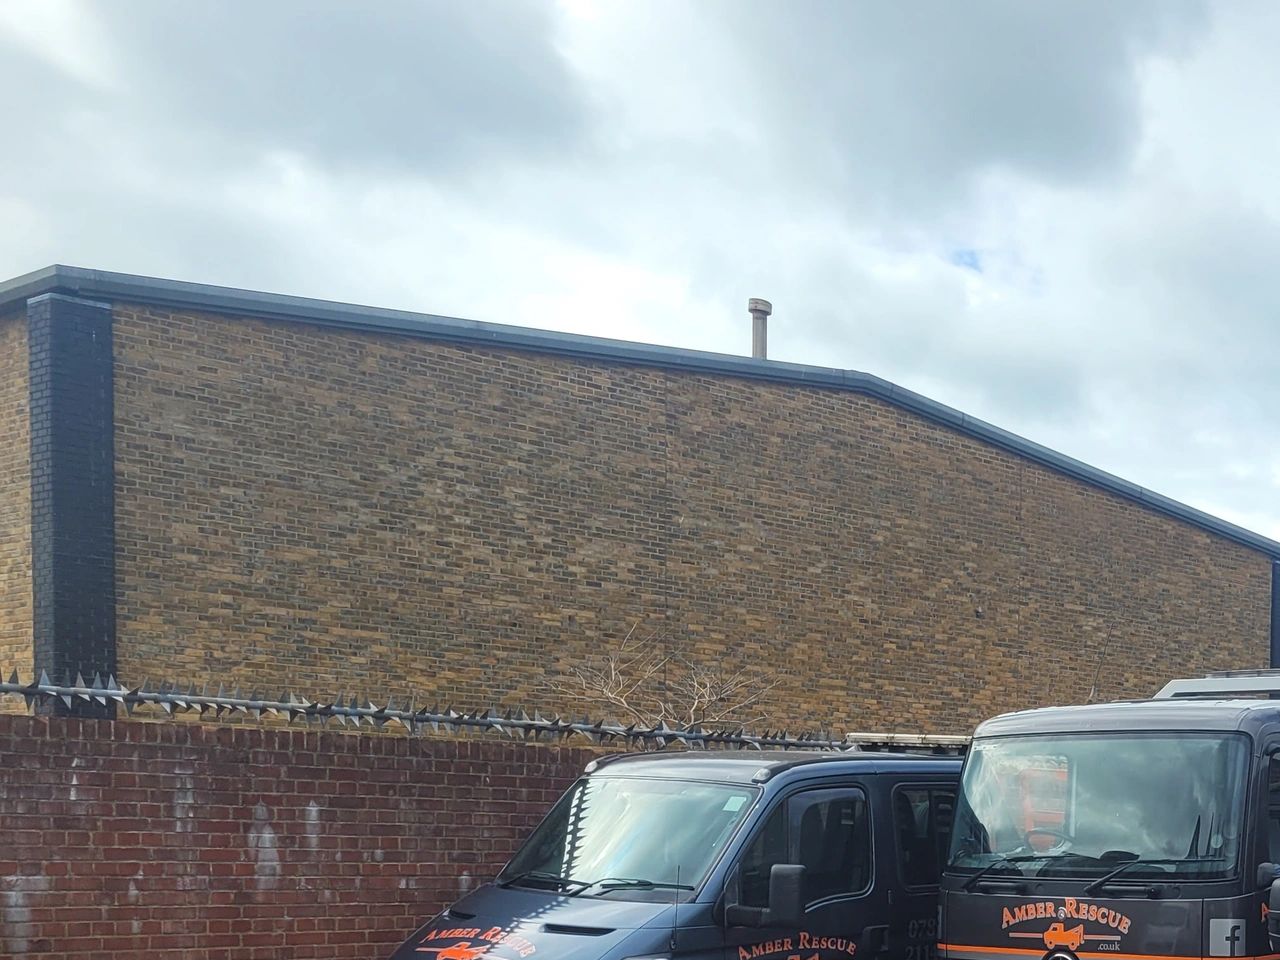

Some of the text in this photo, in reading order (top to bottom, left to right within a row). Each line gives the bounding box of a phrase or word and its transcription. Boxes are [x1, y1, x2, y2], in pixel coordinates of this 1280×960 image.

[1001, 897, 1131, 934] AMBER RESCUE
[420, 928, 481, 943] AMBER
[798, 931, 857, 955] RESCUE
